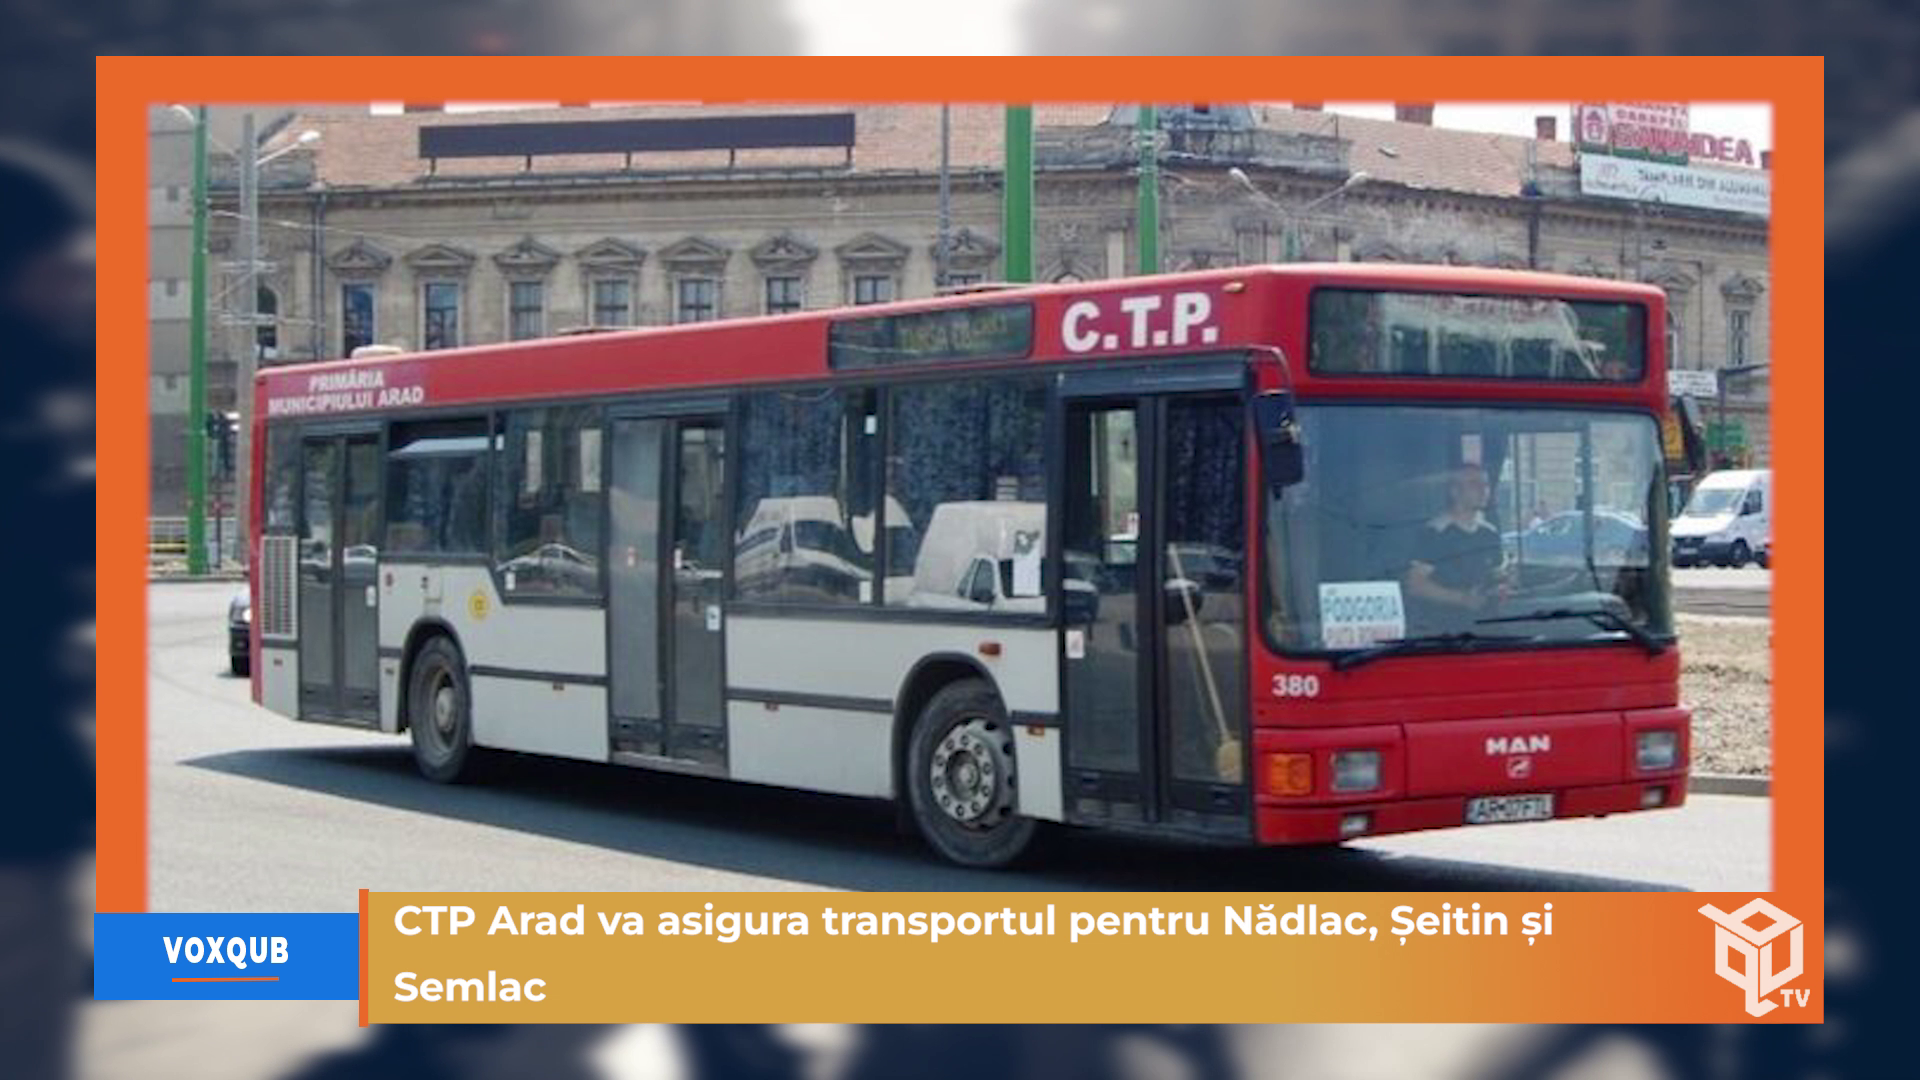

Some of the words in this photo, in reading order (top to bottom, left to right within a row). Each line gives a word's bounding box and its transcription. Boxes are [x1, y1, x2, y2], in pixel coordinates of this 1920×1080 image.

[1061, 292, 1219, 353] C.T.P.
[268, 393, 374, 416] MUNICIPIULUI
[377, 386, 424, 407] ARAD
[1272, 674, 1319, 697] 380
[1485, 735, 1550, 756] MAN
